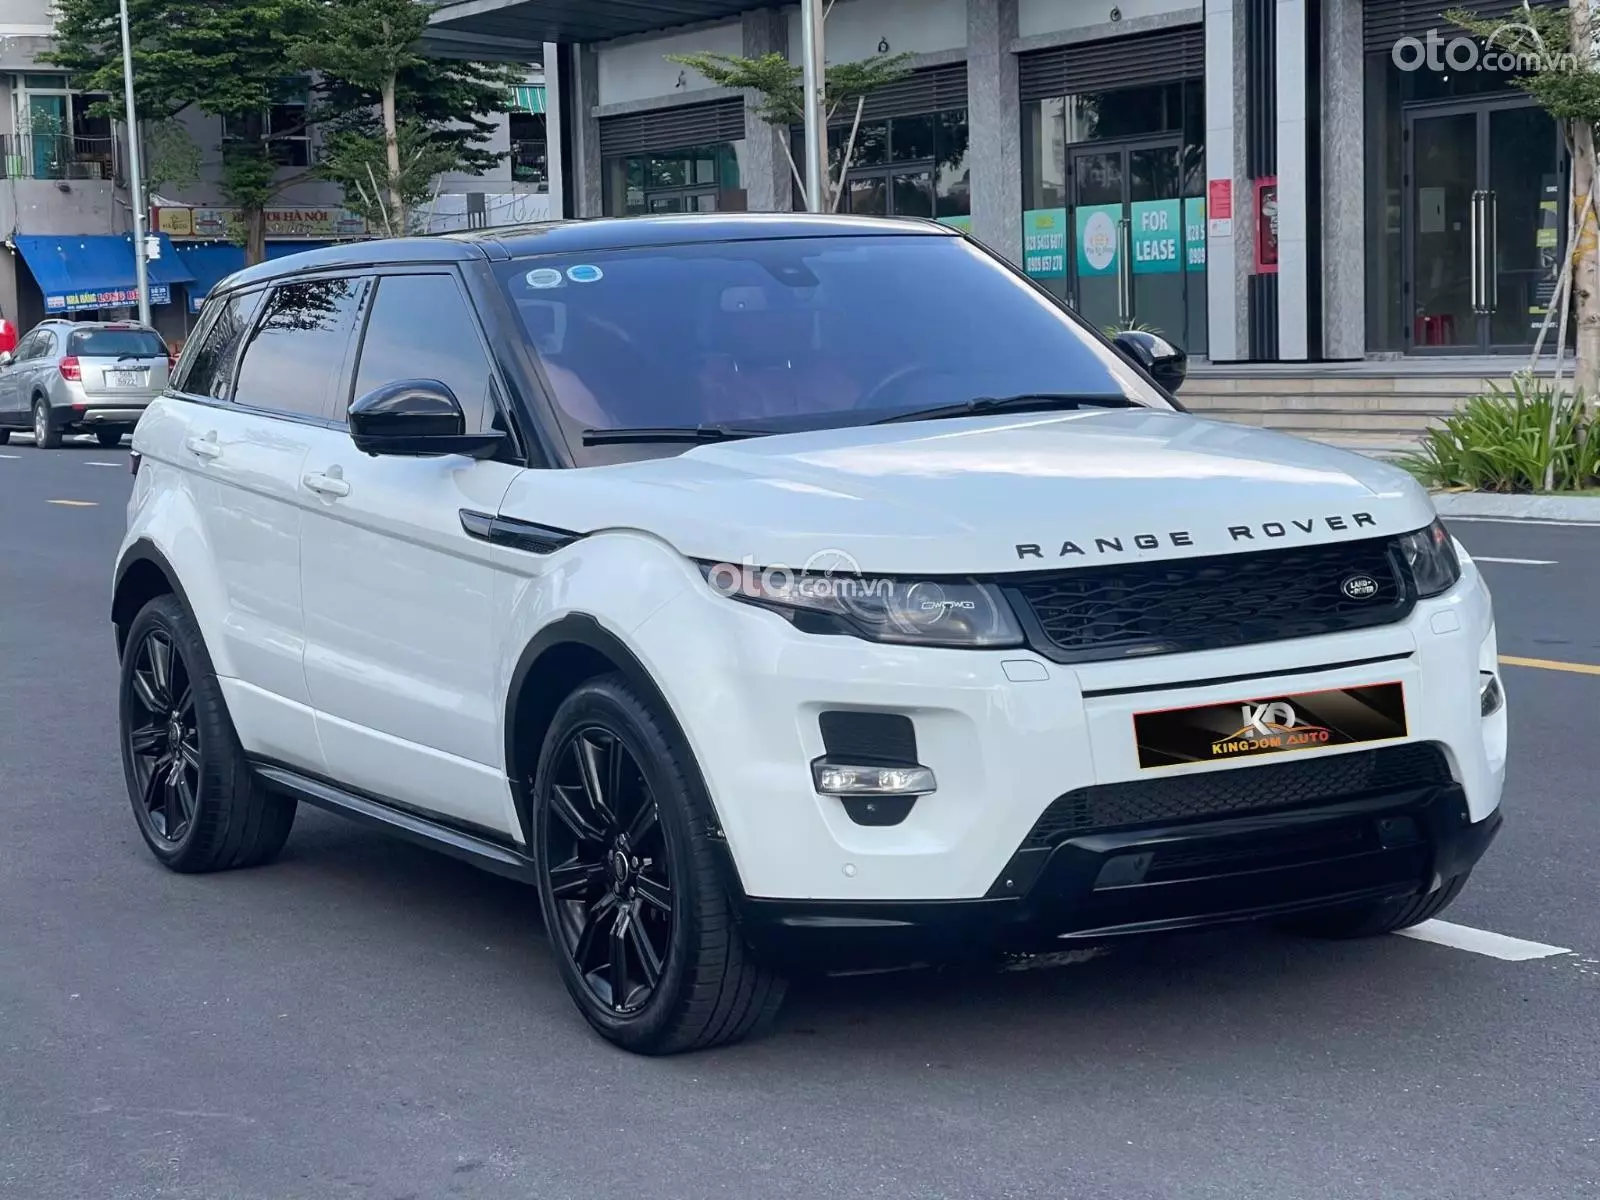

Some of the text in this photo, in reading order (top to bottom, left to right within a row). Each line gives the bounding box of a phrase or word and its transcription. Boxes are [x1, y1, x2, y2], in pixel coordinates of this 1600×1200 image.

[1141, 211, 1168, 232] FOR
[1136, 239, 1176, 261] LEASE
[1015, 512, 1377, 560] RANGE ROVER
